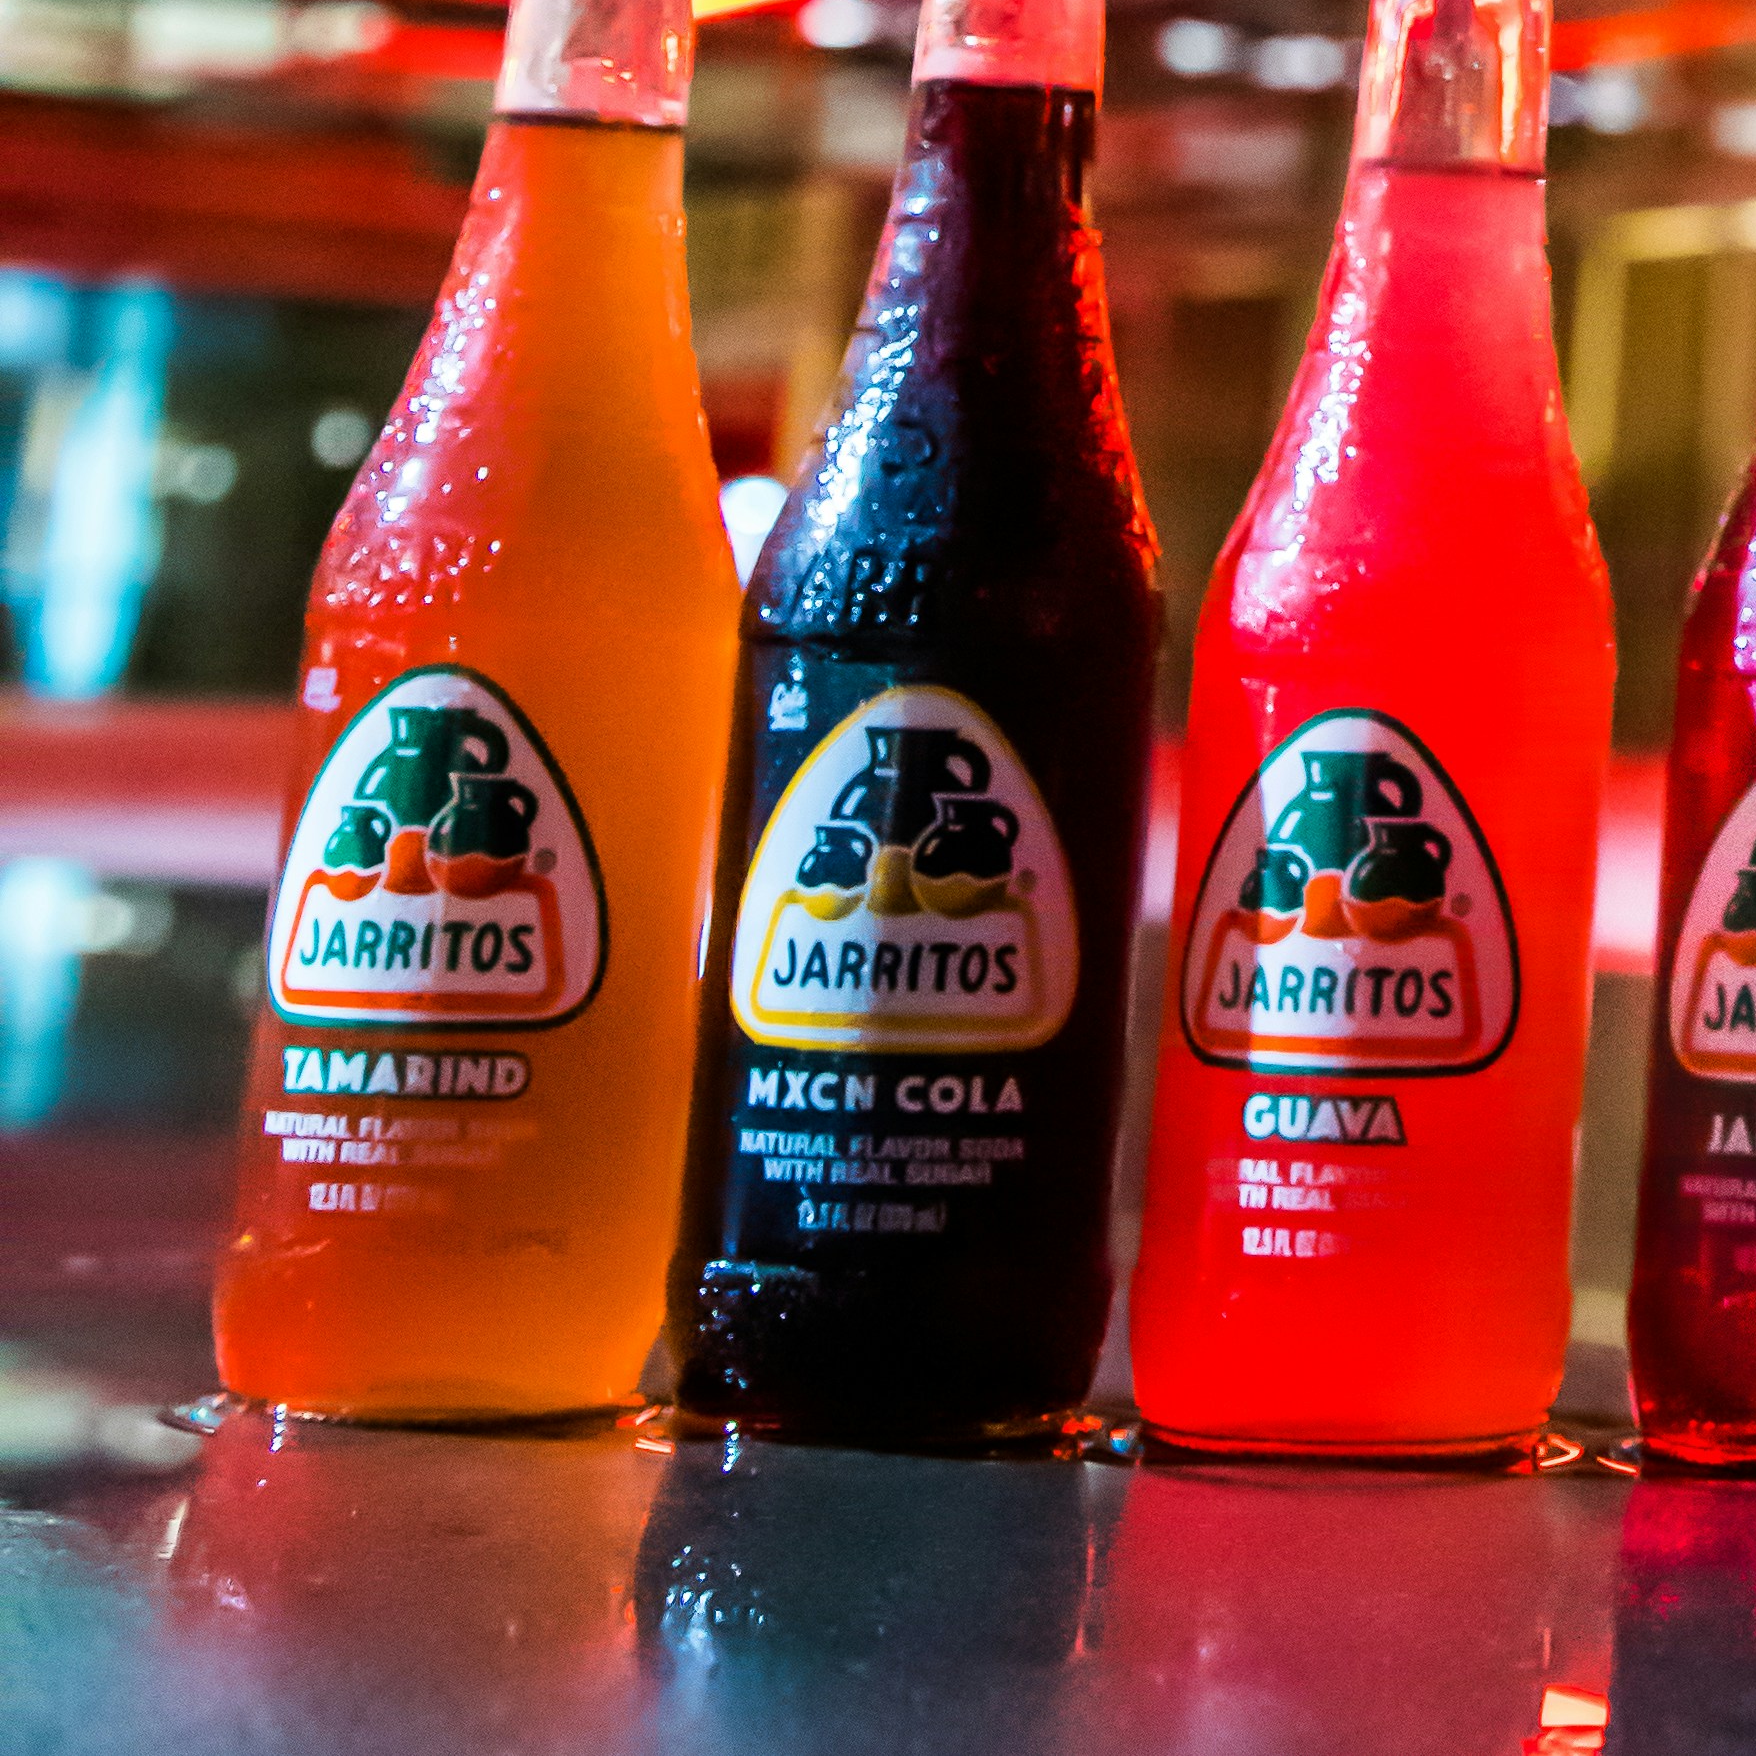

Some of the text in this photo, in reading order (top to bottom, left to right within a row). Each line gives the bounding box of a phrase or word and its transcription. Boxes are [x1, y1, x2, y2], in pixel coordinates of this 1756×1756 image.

[300, 919, 534, 973] JARRITOS
[773, 939, 1019, 994] JARRITOS
[1218, 960, 1454, 1019] JARRITOS
[284, 1047, 528, 1095] TAMARIND
[749, 1067, 1024, 1114] MXCN COLA
[1244, 1094, 1406, 1144] GUAVA
[282, 1138, 335, 1163] WITH
[739, 1130, 840, 1158] NATURAL
[763, 1157, 824, 1183] WITH
[831, 1161, 897, 1185] REAL
